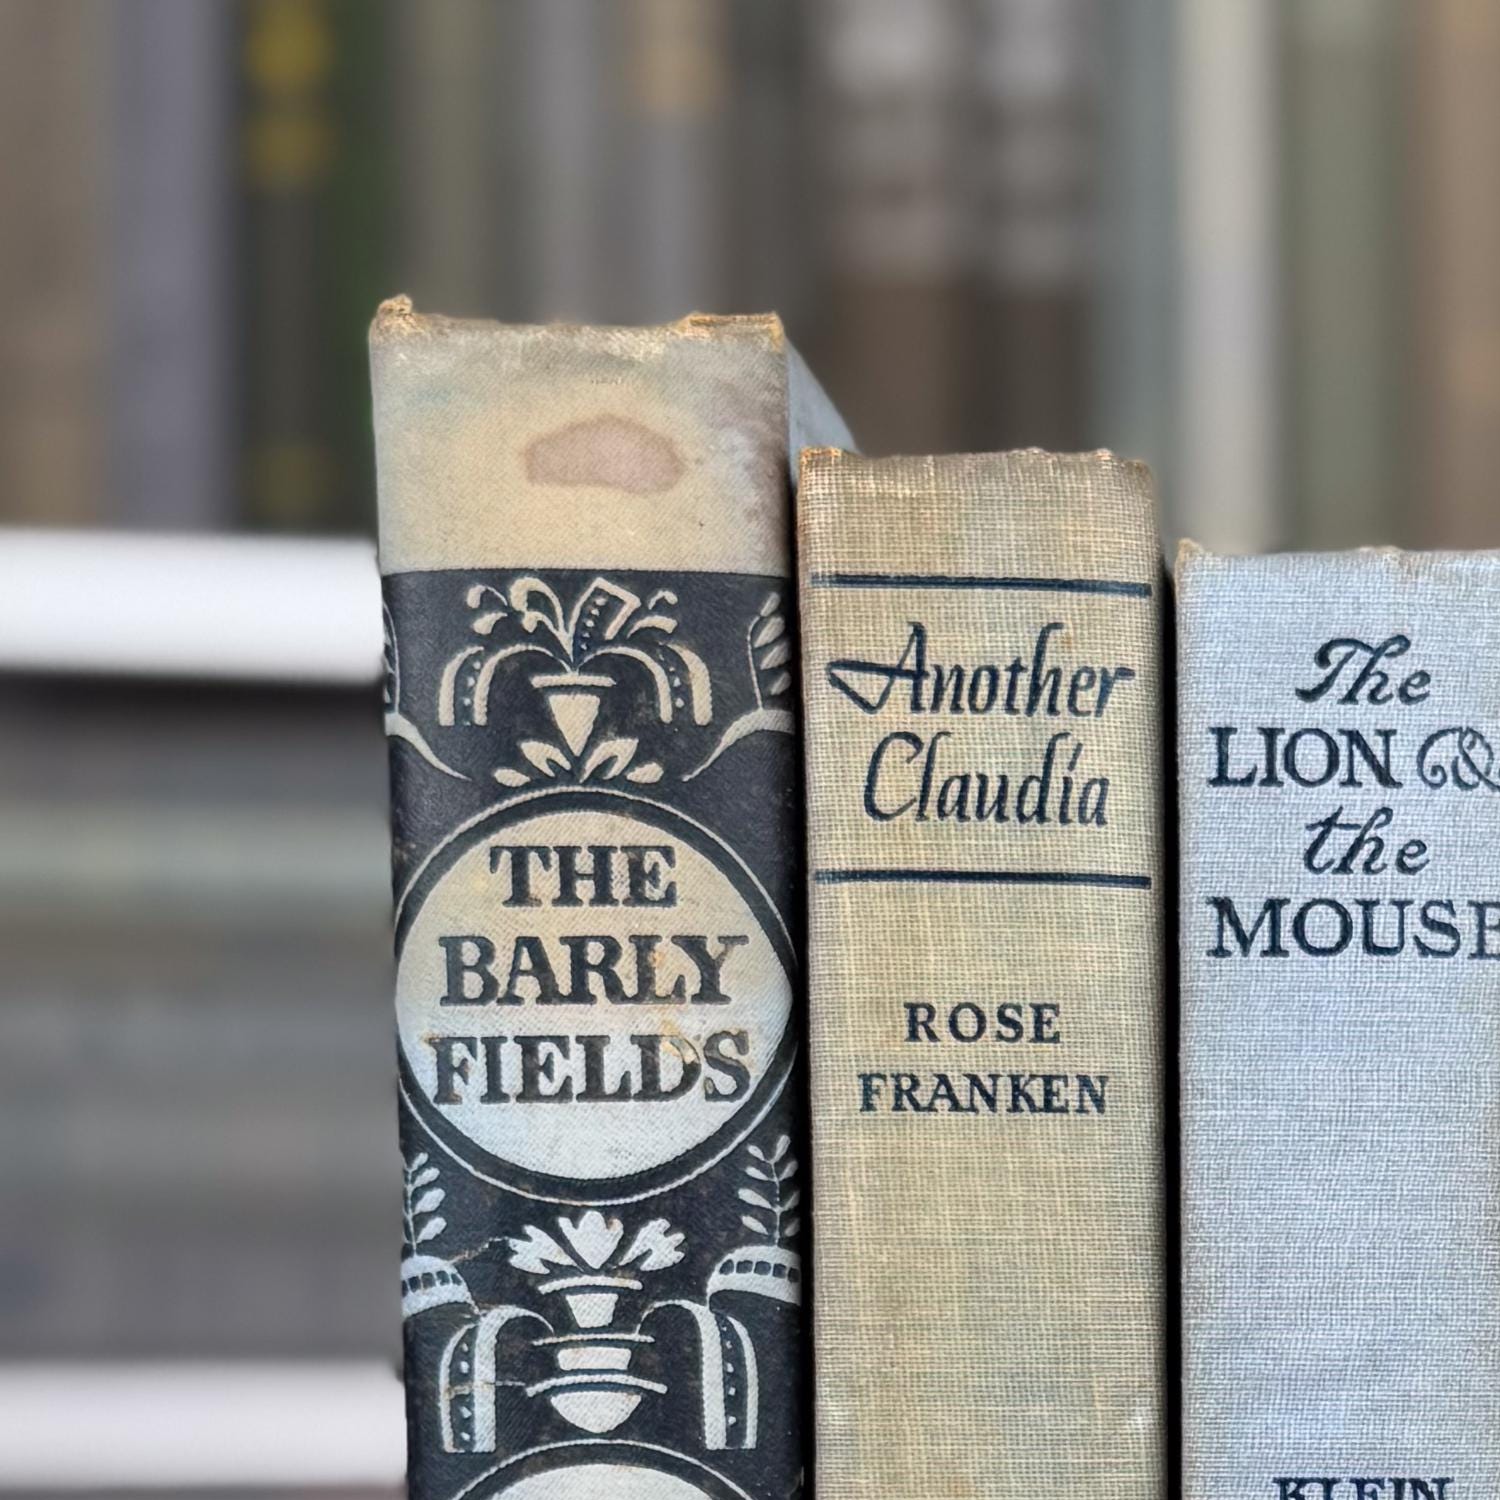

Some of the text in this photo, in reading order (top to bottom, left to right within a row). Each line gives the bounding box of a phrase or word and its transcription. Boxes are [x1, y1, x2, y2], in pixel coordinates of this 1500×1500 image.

[826, 621, 1135, 718] Another
[1295, 634, 1431, 705] The
[865, 731, 1109, 826] Claudia
[1208, 727, 1403, 788] LION
[1304, 806, 1430, 875] the
[490, 846, 677, 907] THE
[439, 935, 749, 1006] BARLY
[904, 1002, 1061, 1044] ROSE
[428, 1030, 750, 1104] FIELDS
[859, 1072, 1108, 1115] FRANKEN
